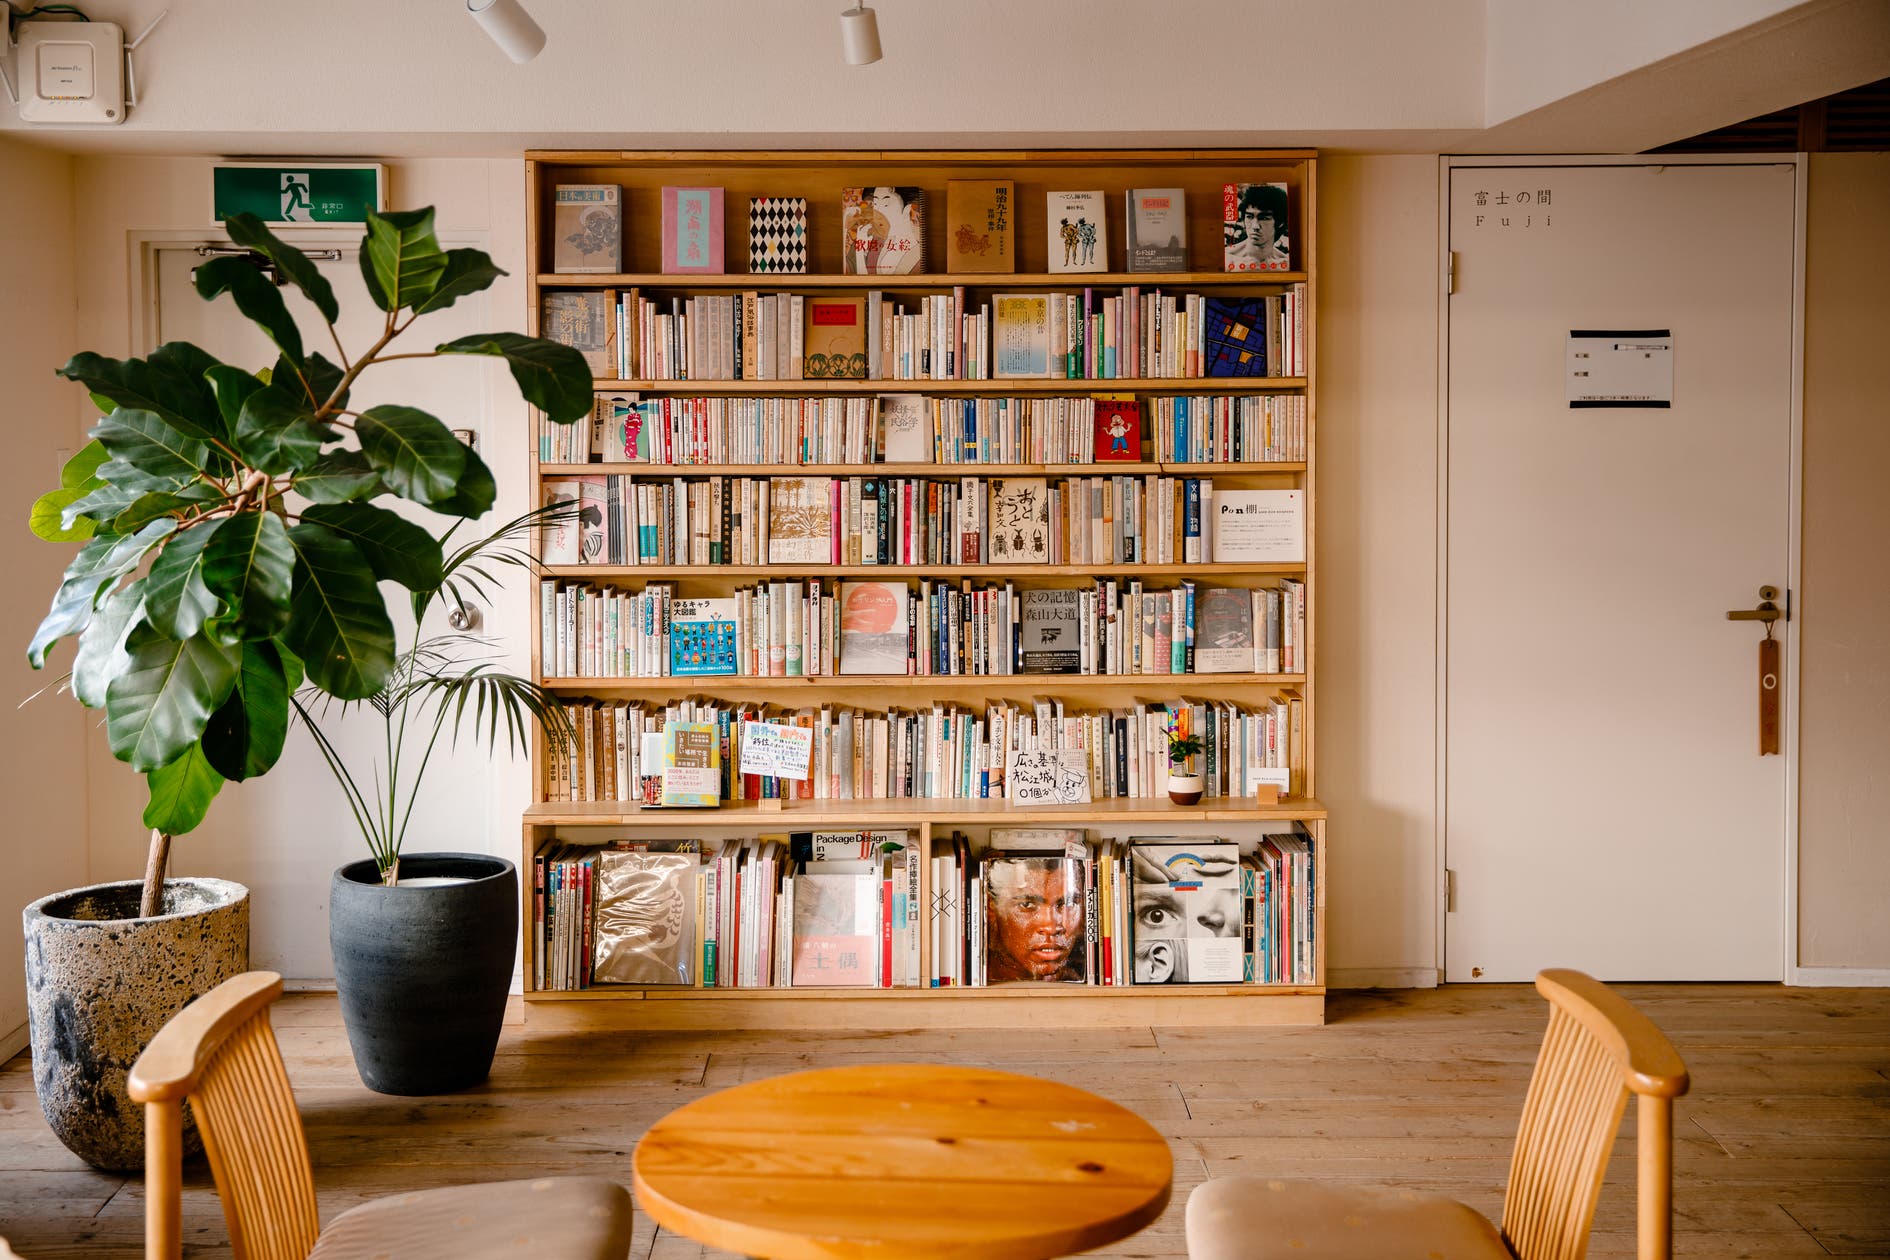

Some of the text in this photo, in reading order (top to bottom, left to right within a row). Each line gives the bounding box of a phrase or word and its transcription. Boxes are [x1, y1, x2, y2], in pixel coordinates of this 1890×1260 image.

[559, 191, 601, 201] 日本の美術
[1474, 190, 1552, 206] 富士の間
[321, 202, 344, 210] 非常口
[995, 187, 1008, 232] 明治九十九年
[1475, 215, 1551, 228] Fuji
[854, 239, 911, 252] 歌麿の女絵
[673, 600, 711, 608] ゆるキャラ
[1025, 591, 1077, 604] 犬の記憶
[673, 608, 697, 616] 大図鑑
[1025, 608, 1077, 621] 森山大道
[1013, 768, 1054, 784] 松江城
[816, 834, 887, 845] Package Design
[951, 978, 956, 986] 1
